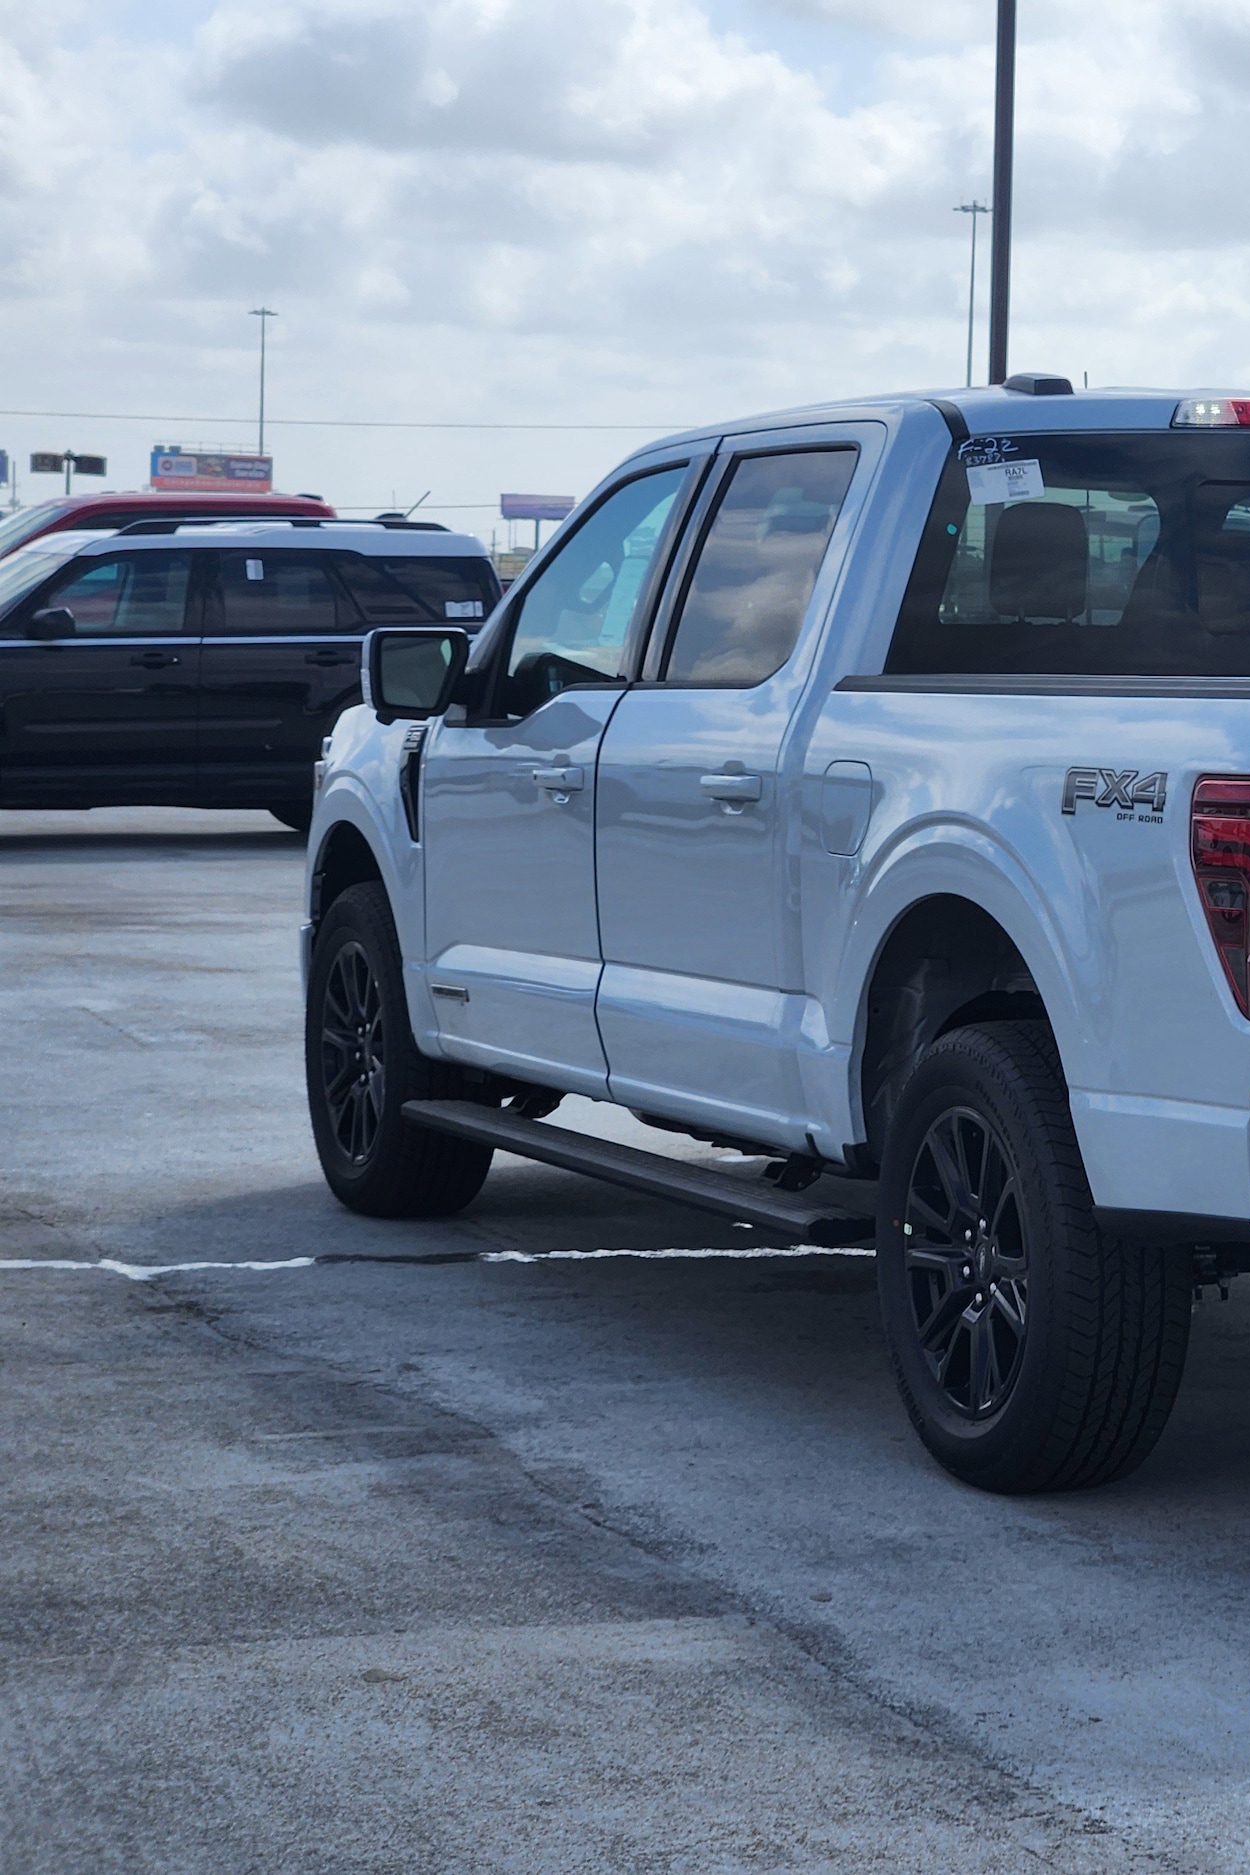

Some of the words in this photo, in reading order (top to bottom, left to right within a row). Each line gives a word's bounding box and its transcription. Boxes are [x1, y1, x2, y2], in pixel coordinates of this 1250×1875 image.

[1061, 766, 1168, 815] FX4
[1116, 812, 1135, 822] OFF
[1138, 815, 1164, 824] ROAD
